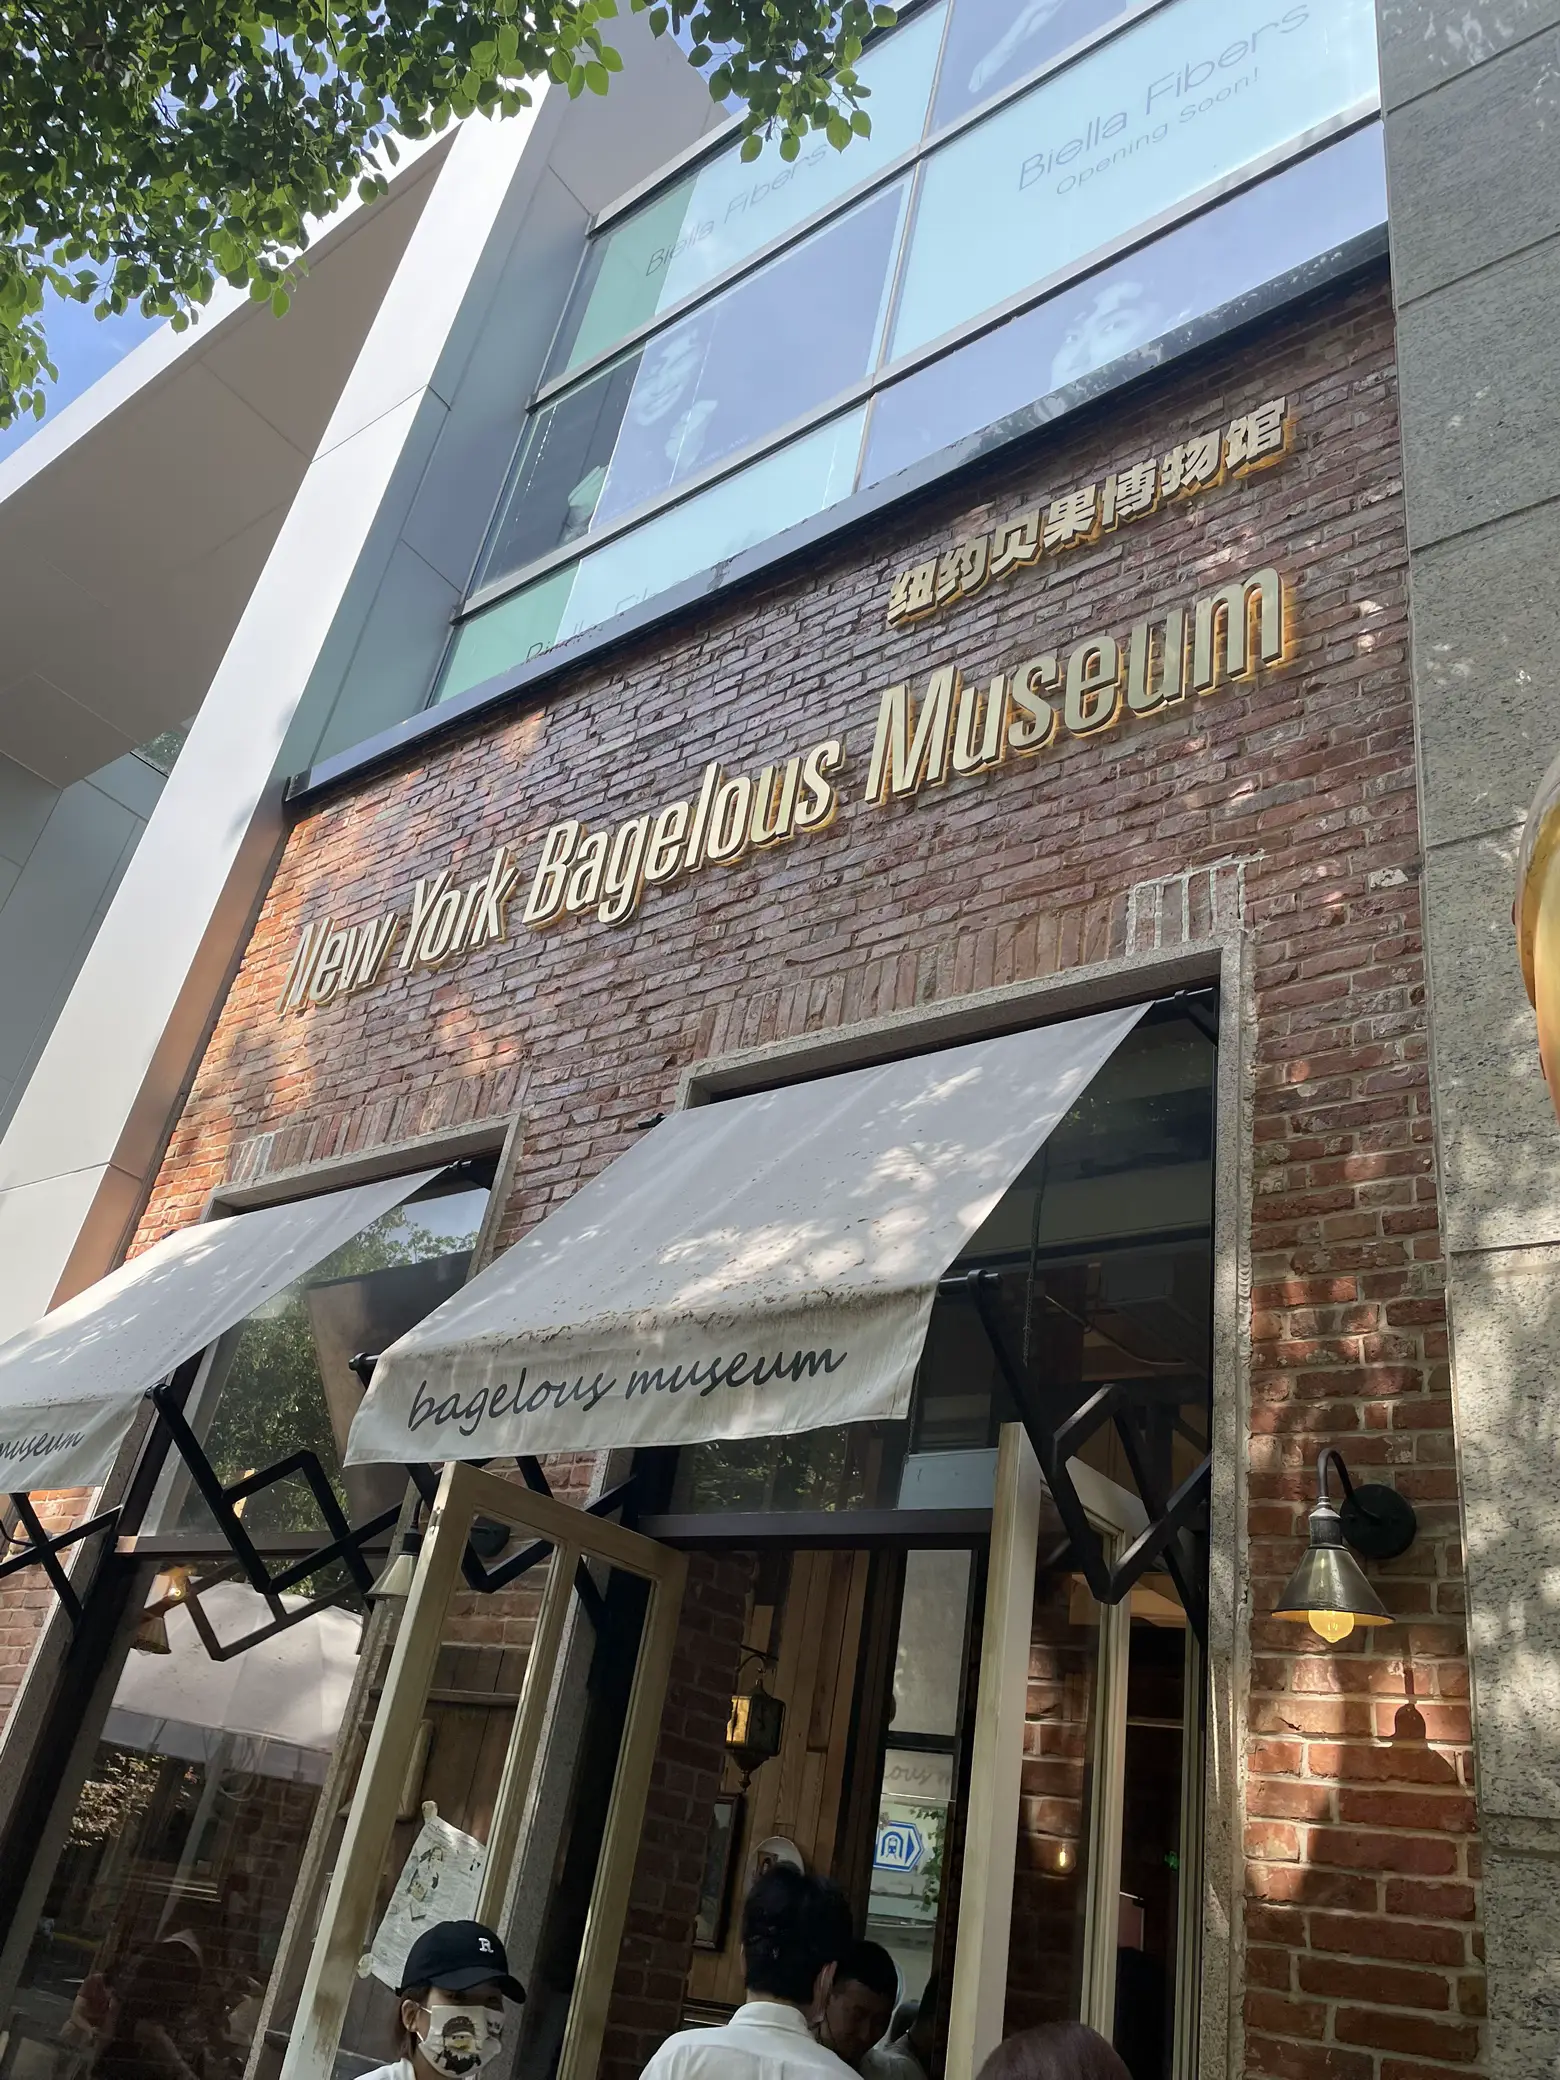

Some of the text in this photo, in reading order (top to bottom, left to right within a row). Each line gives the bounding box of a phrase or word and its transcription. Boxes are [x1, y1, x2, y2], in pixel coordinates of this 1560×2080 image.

[1018, 4, 1310, 191] Biella Fibers
[1056, 122, 1168, 195] Opening
[645, 143, 828, 277] Biella Fibers
[887, 396, 1289, 626] 纽约贝果博物馆
[276, 566, 1288, 1018] New York Bagelous Museum
[406, 1346, 848, 1437] bagelous museum
